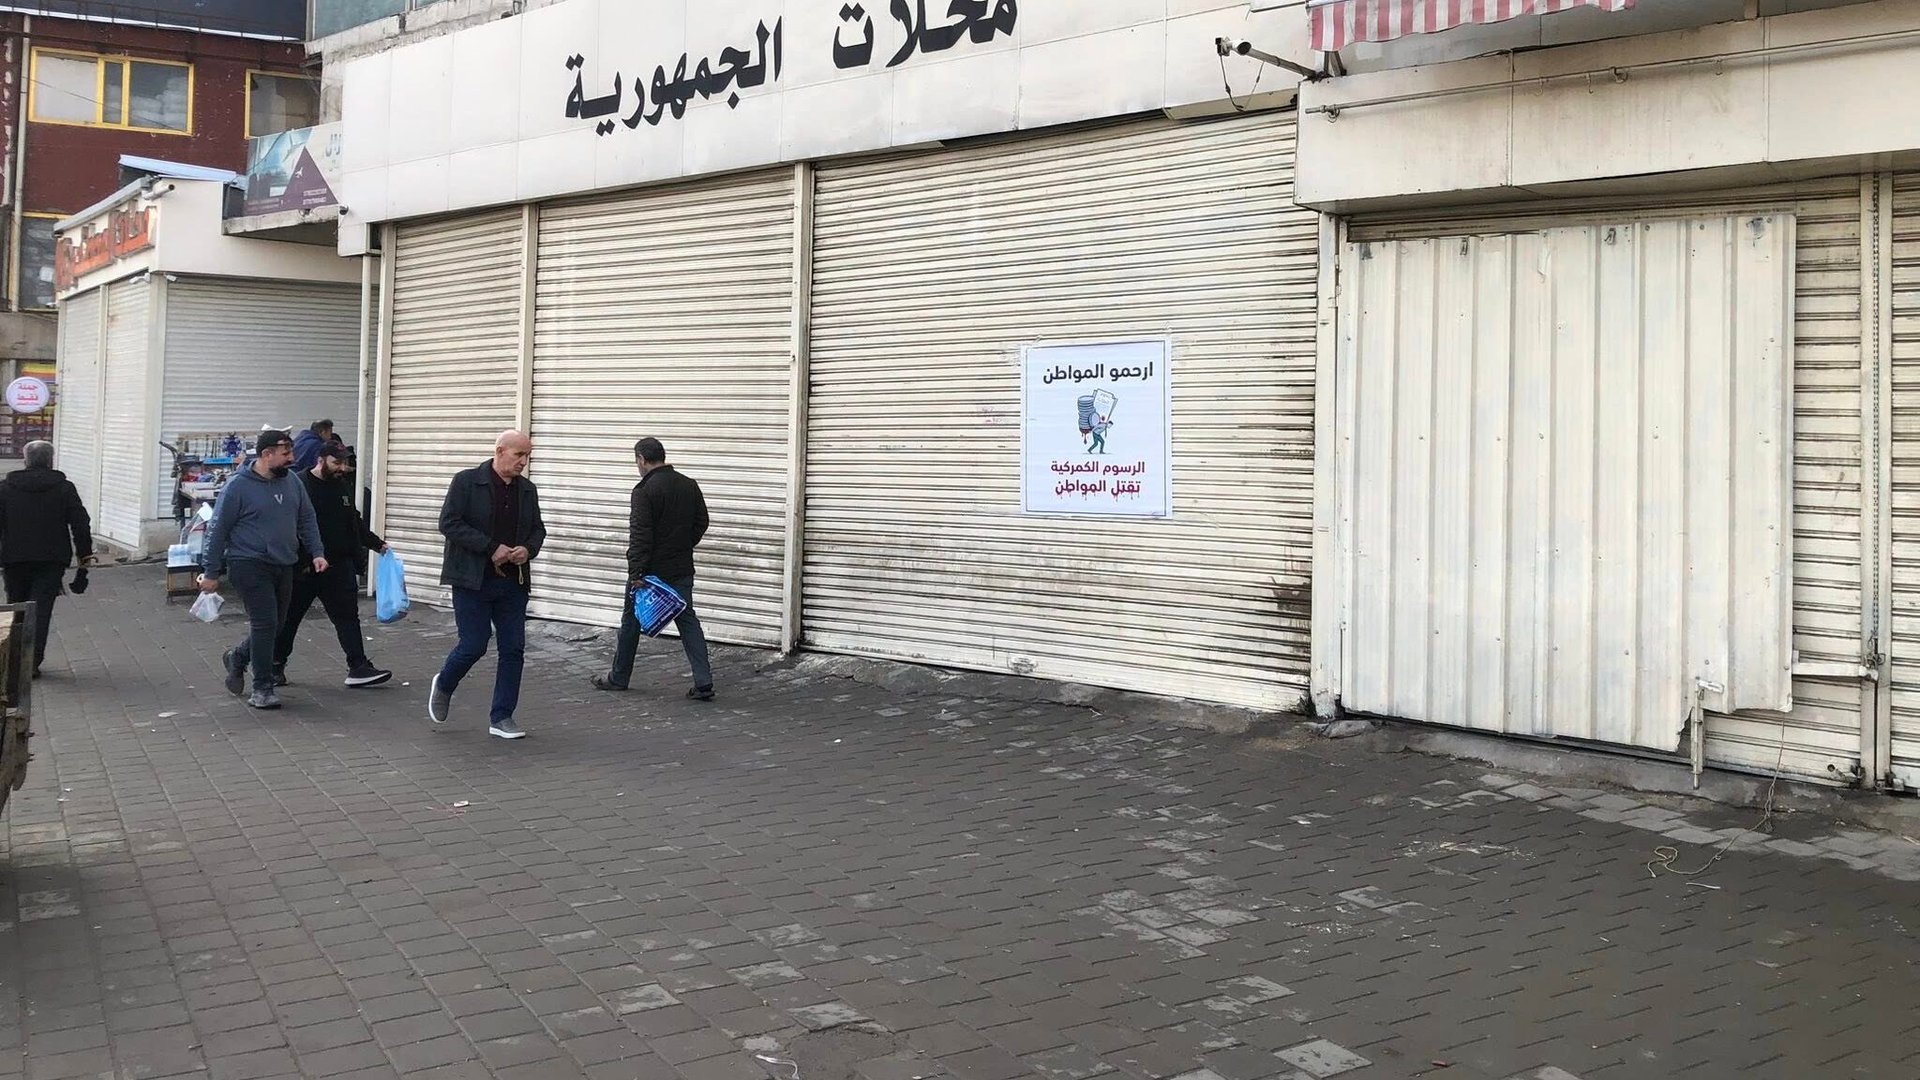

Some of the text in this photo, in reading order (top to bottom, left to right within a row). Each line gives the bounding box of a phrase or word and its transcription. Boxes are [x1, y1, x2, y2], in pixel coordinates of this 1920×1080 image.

[564, 0, 1018, 136] محلات الجمهورية
[1043, 361, 1154, 384] ارحمو المواطن
[1050, 460, 1145, 476] الرسوم الكمركية
[1055, 479, 1141, 496] تقتل المواطن
